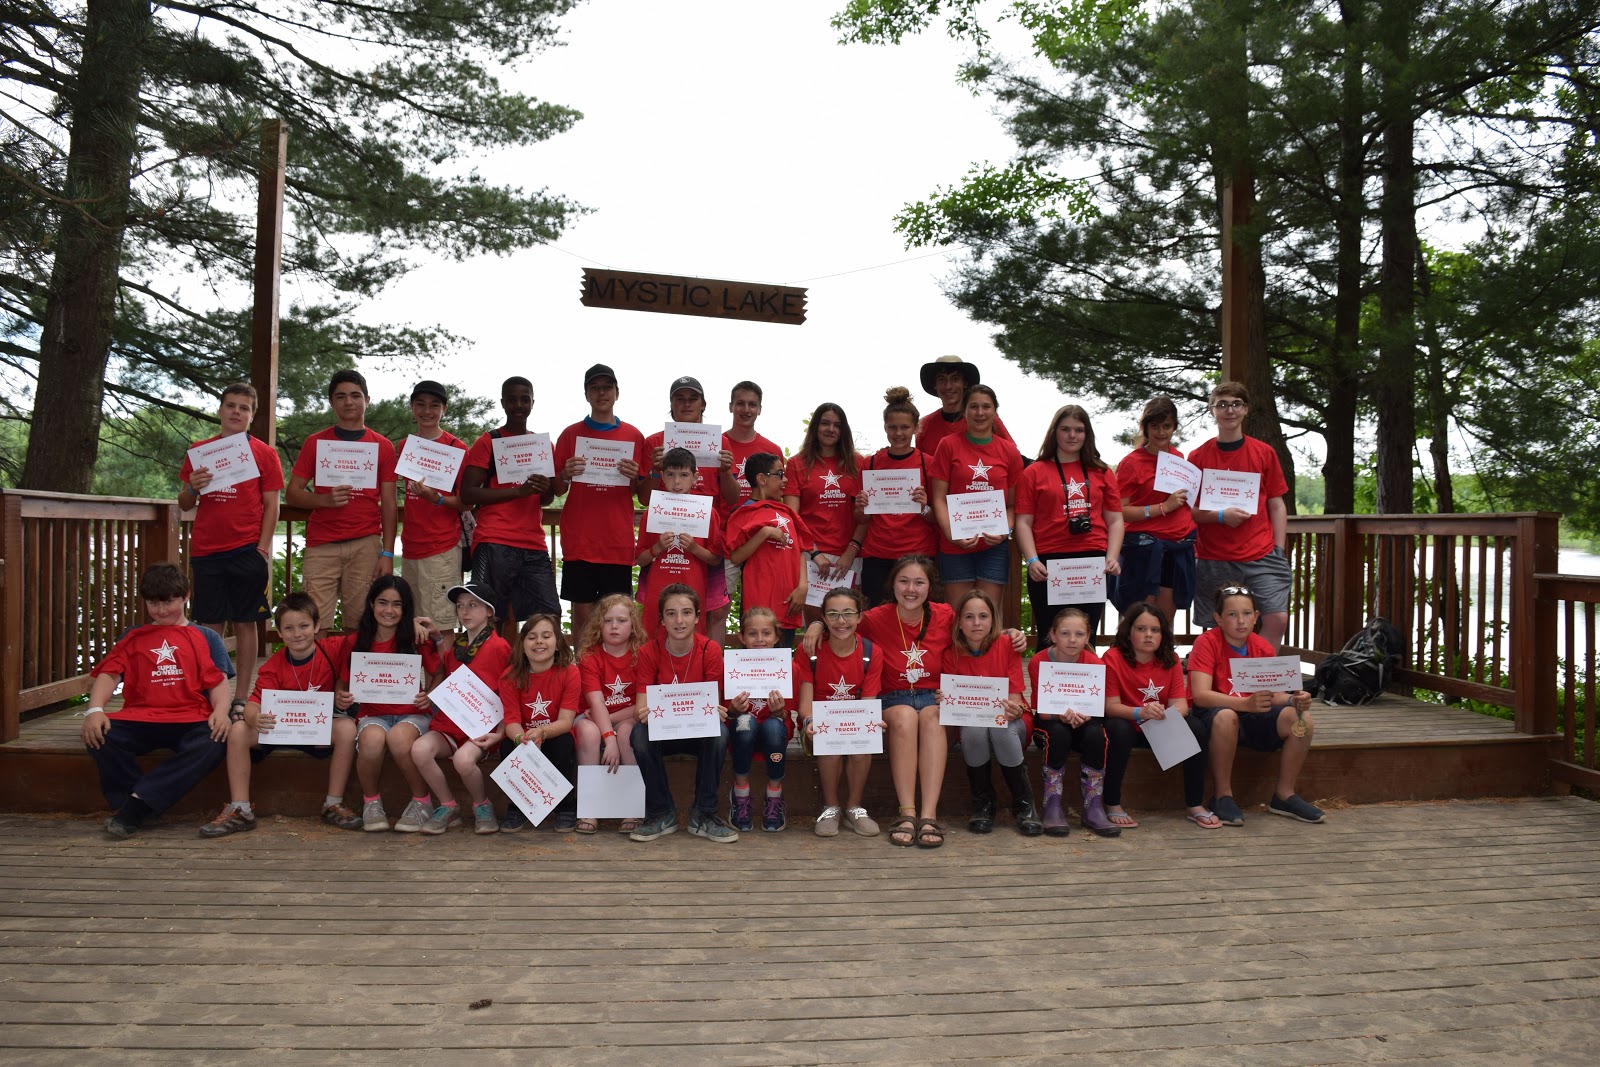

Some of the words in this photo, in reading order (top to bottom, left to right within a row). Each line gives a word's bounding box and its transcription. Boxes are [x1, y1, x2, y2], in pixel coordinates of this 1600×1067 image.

[588, 275, 712, 308] MYSTIC
[722, 287, 802, 317] LAKE
[416, 461, 441, 471] CARROLL
[663, 510, 696, 518] OLMSTEAD
[151, 668, 184, 677] POWERED
[466, 691, 484, 707] ANAIS
[604, 696, 631, 706] OWERED
[520, 775, 539, 795] AUTUMN
